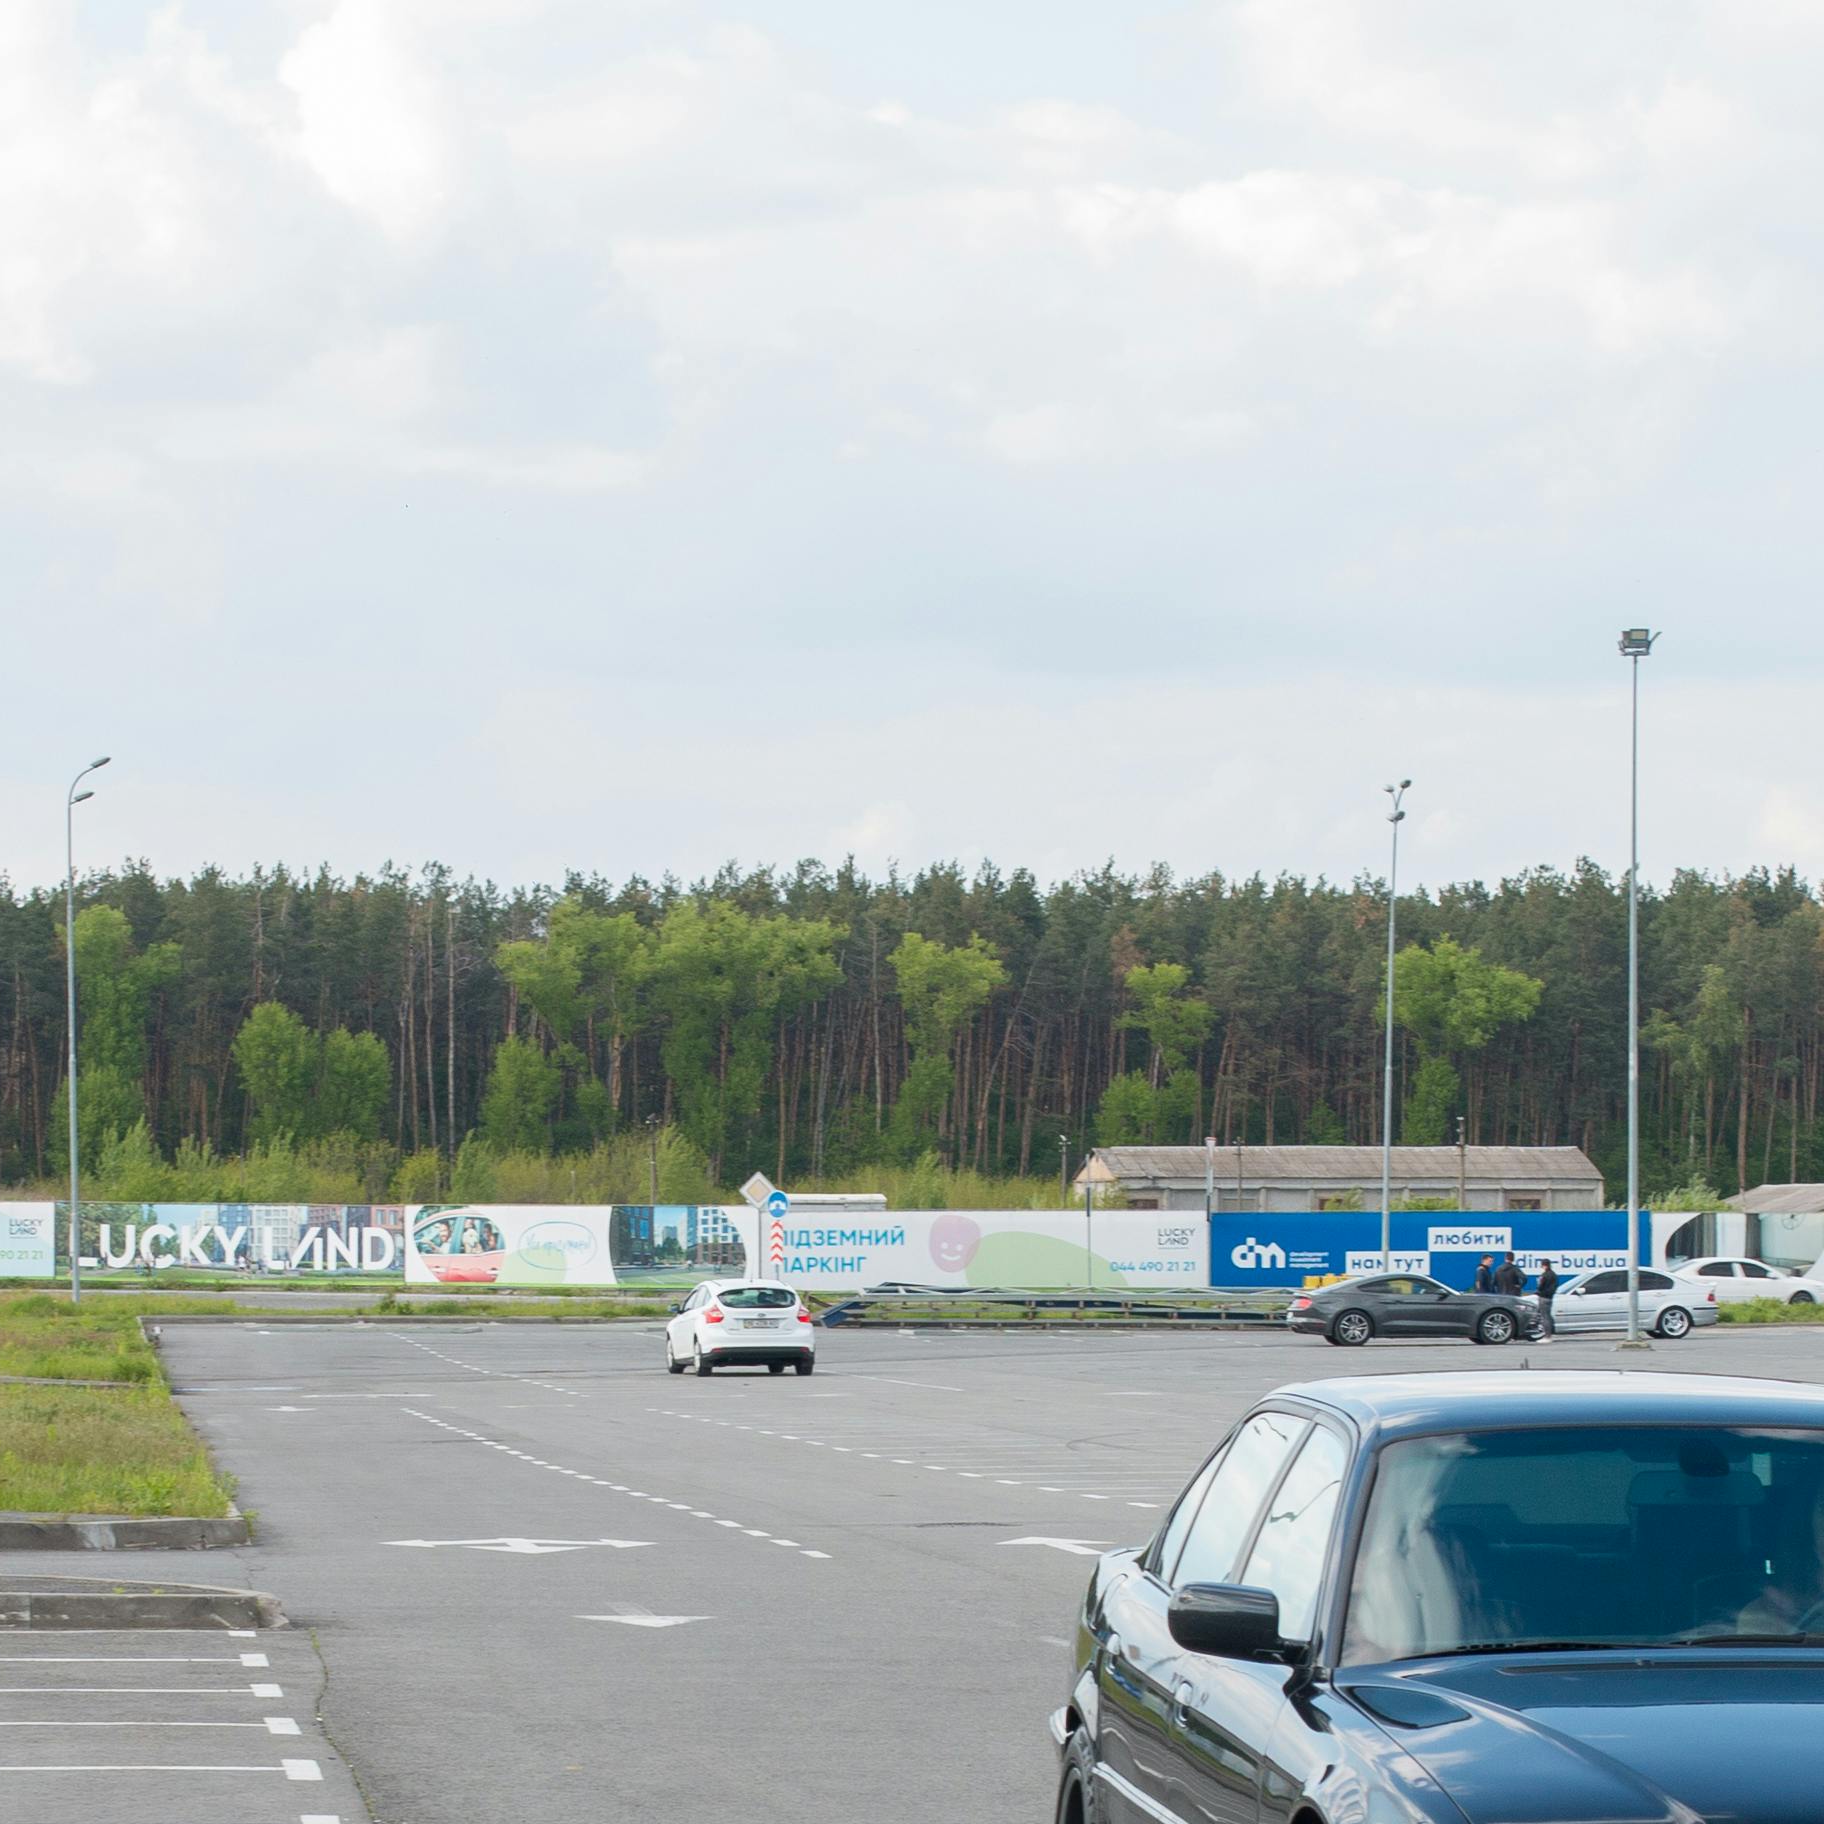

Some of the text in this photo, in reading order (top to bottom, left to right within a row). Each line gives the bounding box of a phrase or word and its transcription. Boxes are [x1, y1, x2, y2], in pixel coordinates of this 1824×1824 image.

[9, 1218, 43, 1227] LUCKY
[1158, 1228, 1195, 1236] LUCKY
[1158, 1237, 1189, 1245] LAND
[1433, 1231, 1505, 1245] любити
[264, 1226, 395, 1270] LAND
[17, 1249, 29, 1260] 21
[31, 1249, 44, 1260] 21
[1110, 1261, 1196, 1272] 044 490 21 21
[1394, 1258, 1424, 1272] тут
